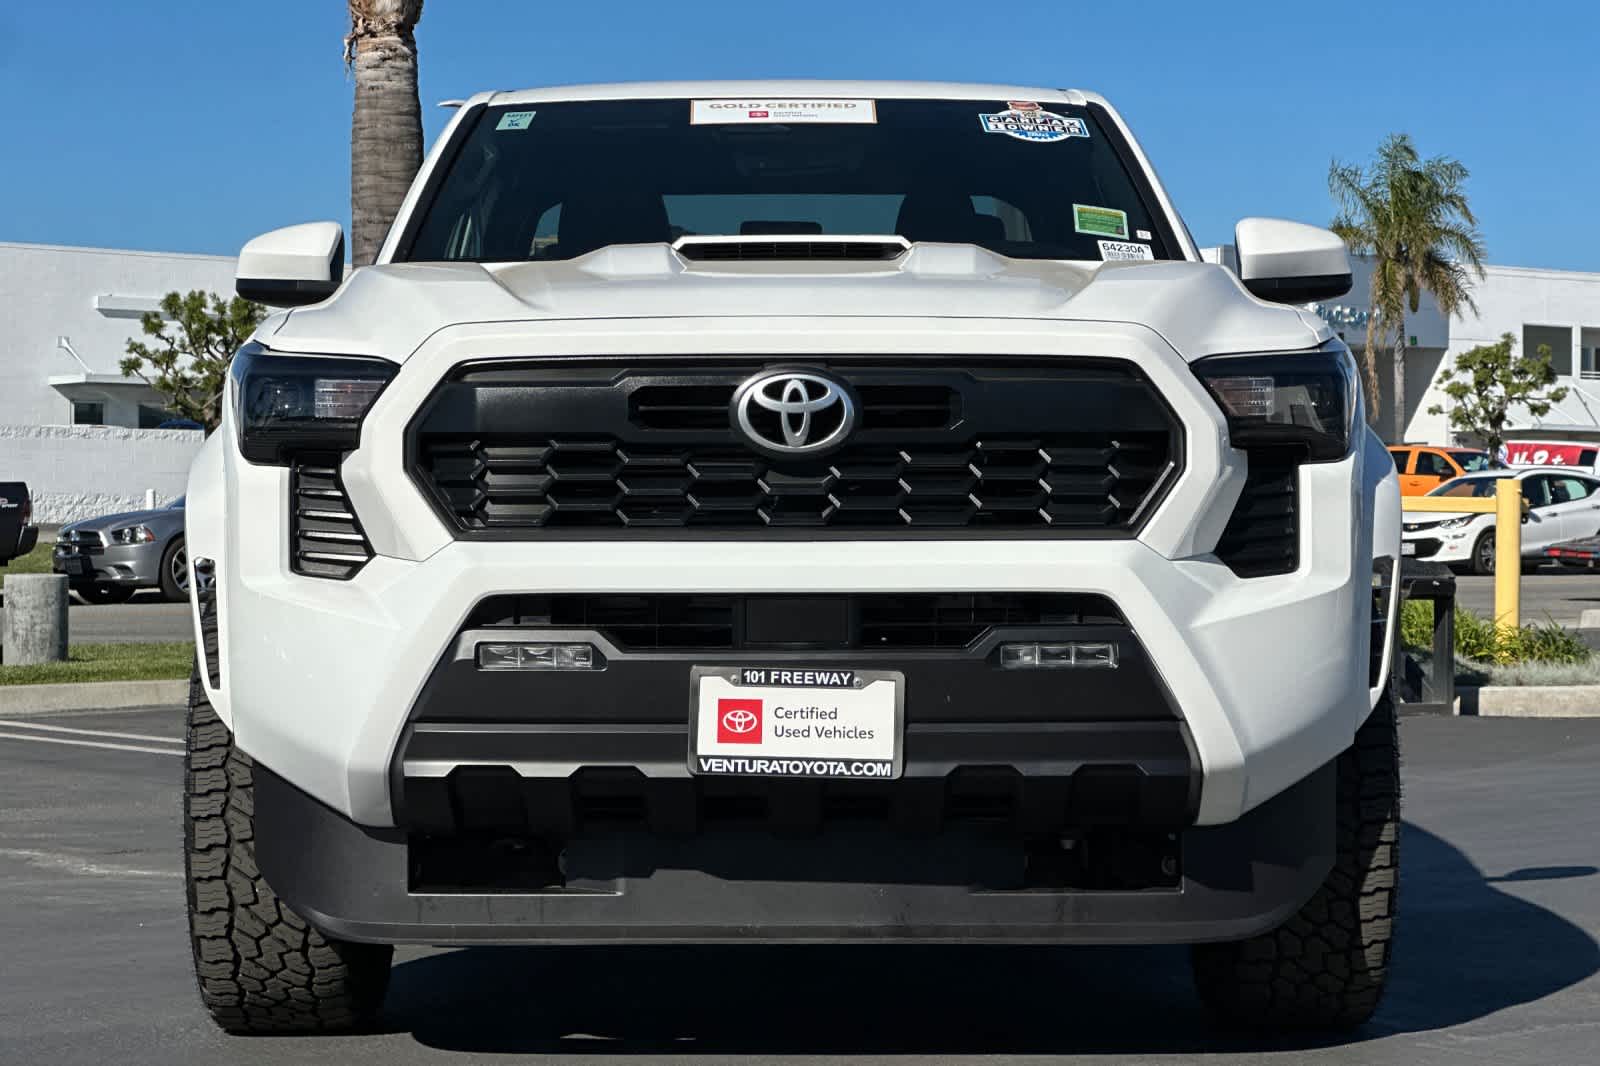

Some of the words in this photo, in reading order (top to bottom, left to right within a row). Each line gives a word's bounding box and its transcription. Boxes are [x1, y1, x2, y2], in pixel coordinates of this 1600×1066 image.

[743, 670, 766, 684] 101
[770, 671, 852, 686] FREEWAY
[773, 706, 838, 720] Certified
[774, 725, 811, 738] Used
[815, 726, 874, 740] Vehicles
[699, 757, 892, 778] VENTURATOYOTA.COM
